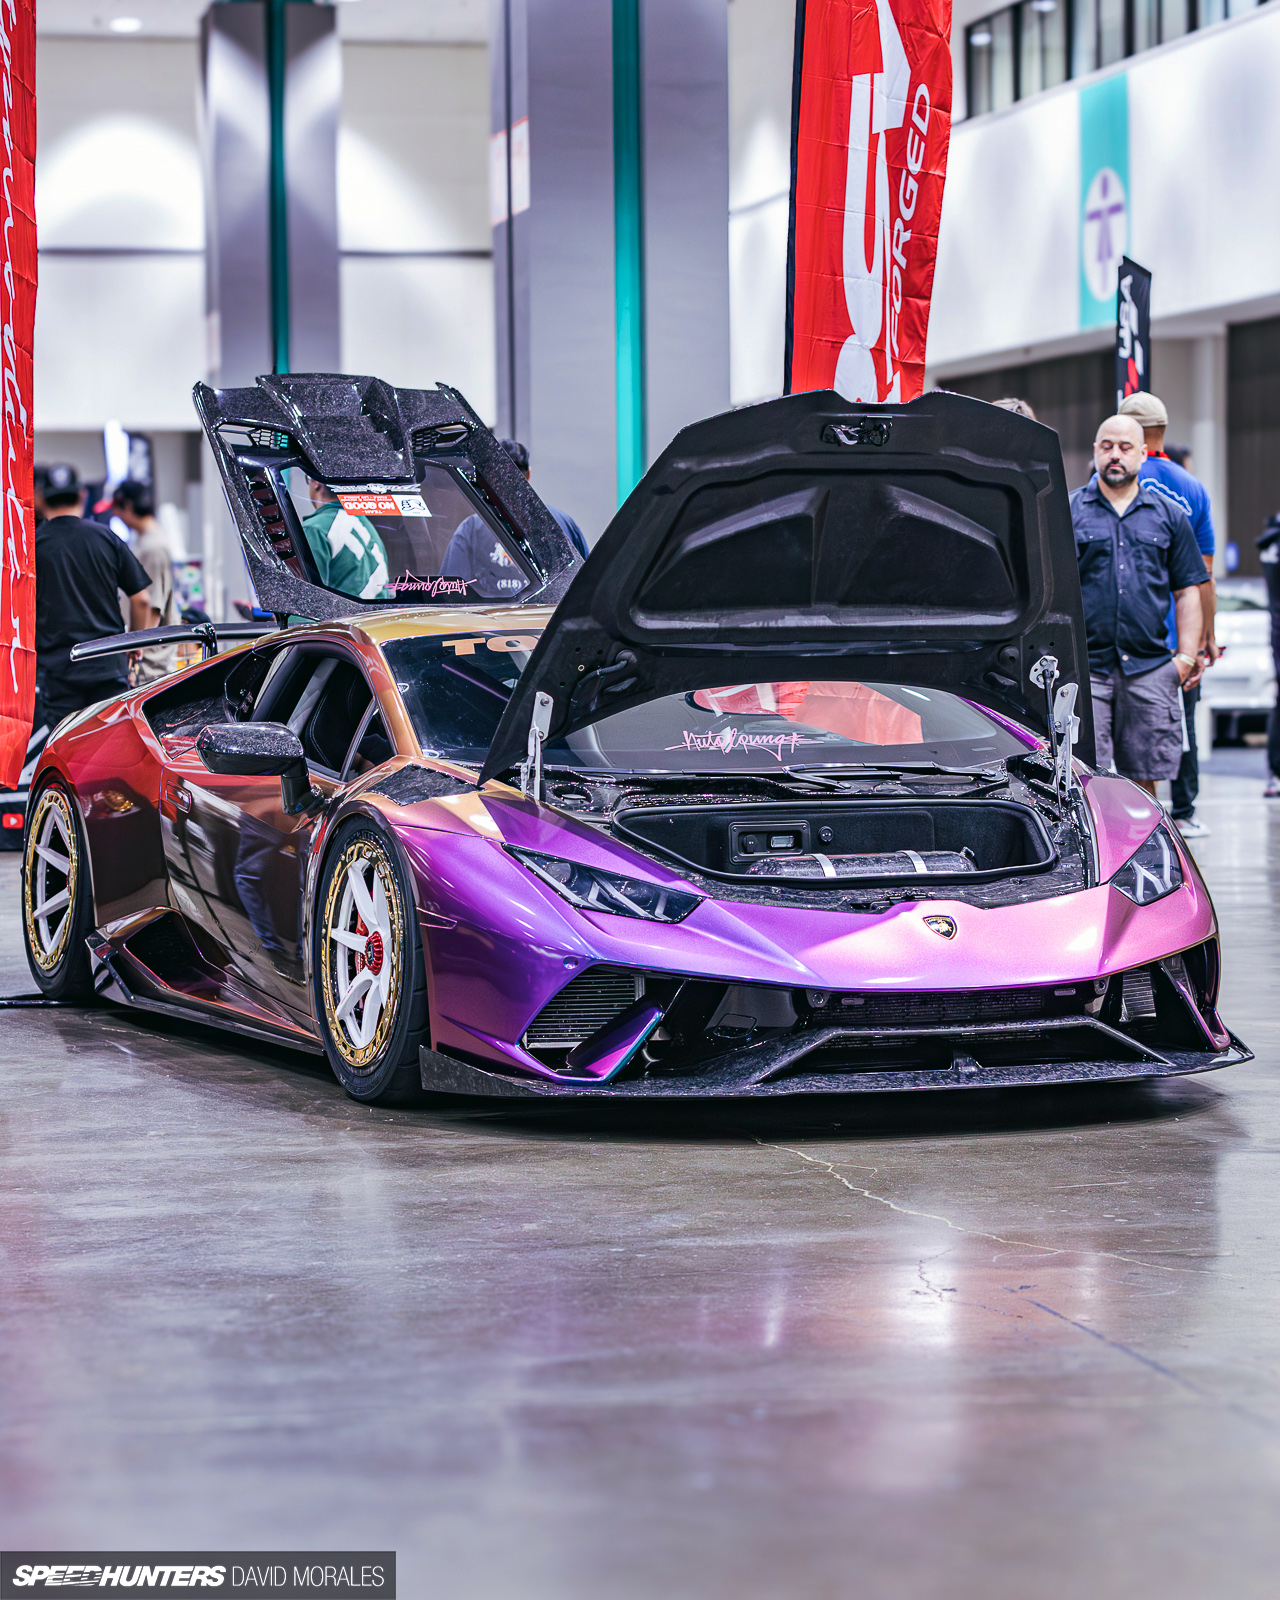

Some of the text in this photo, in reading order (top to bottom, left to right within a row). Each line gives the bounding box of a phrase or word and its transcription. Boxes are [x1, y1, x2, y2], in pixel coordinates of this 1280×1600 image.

[889, 83, 931, 358] FORGED
[344, 501, 396, 510] NO GOOD
[496, 579, 522, 591] (818)
[442, 635, 541, 656] TO
